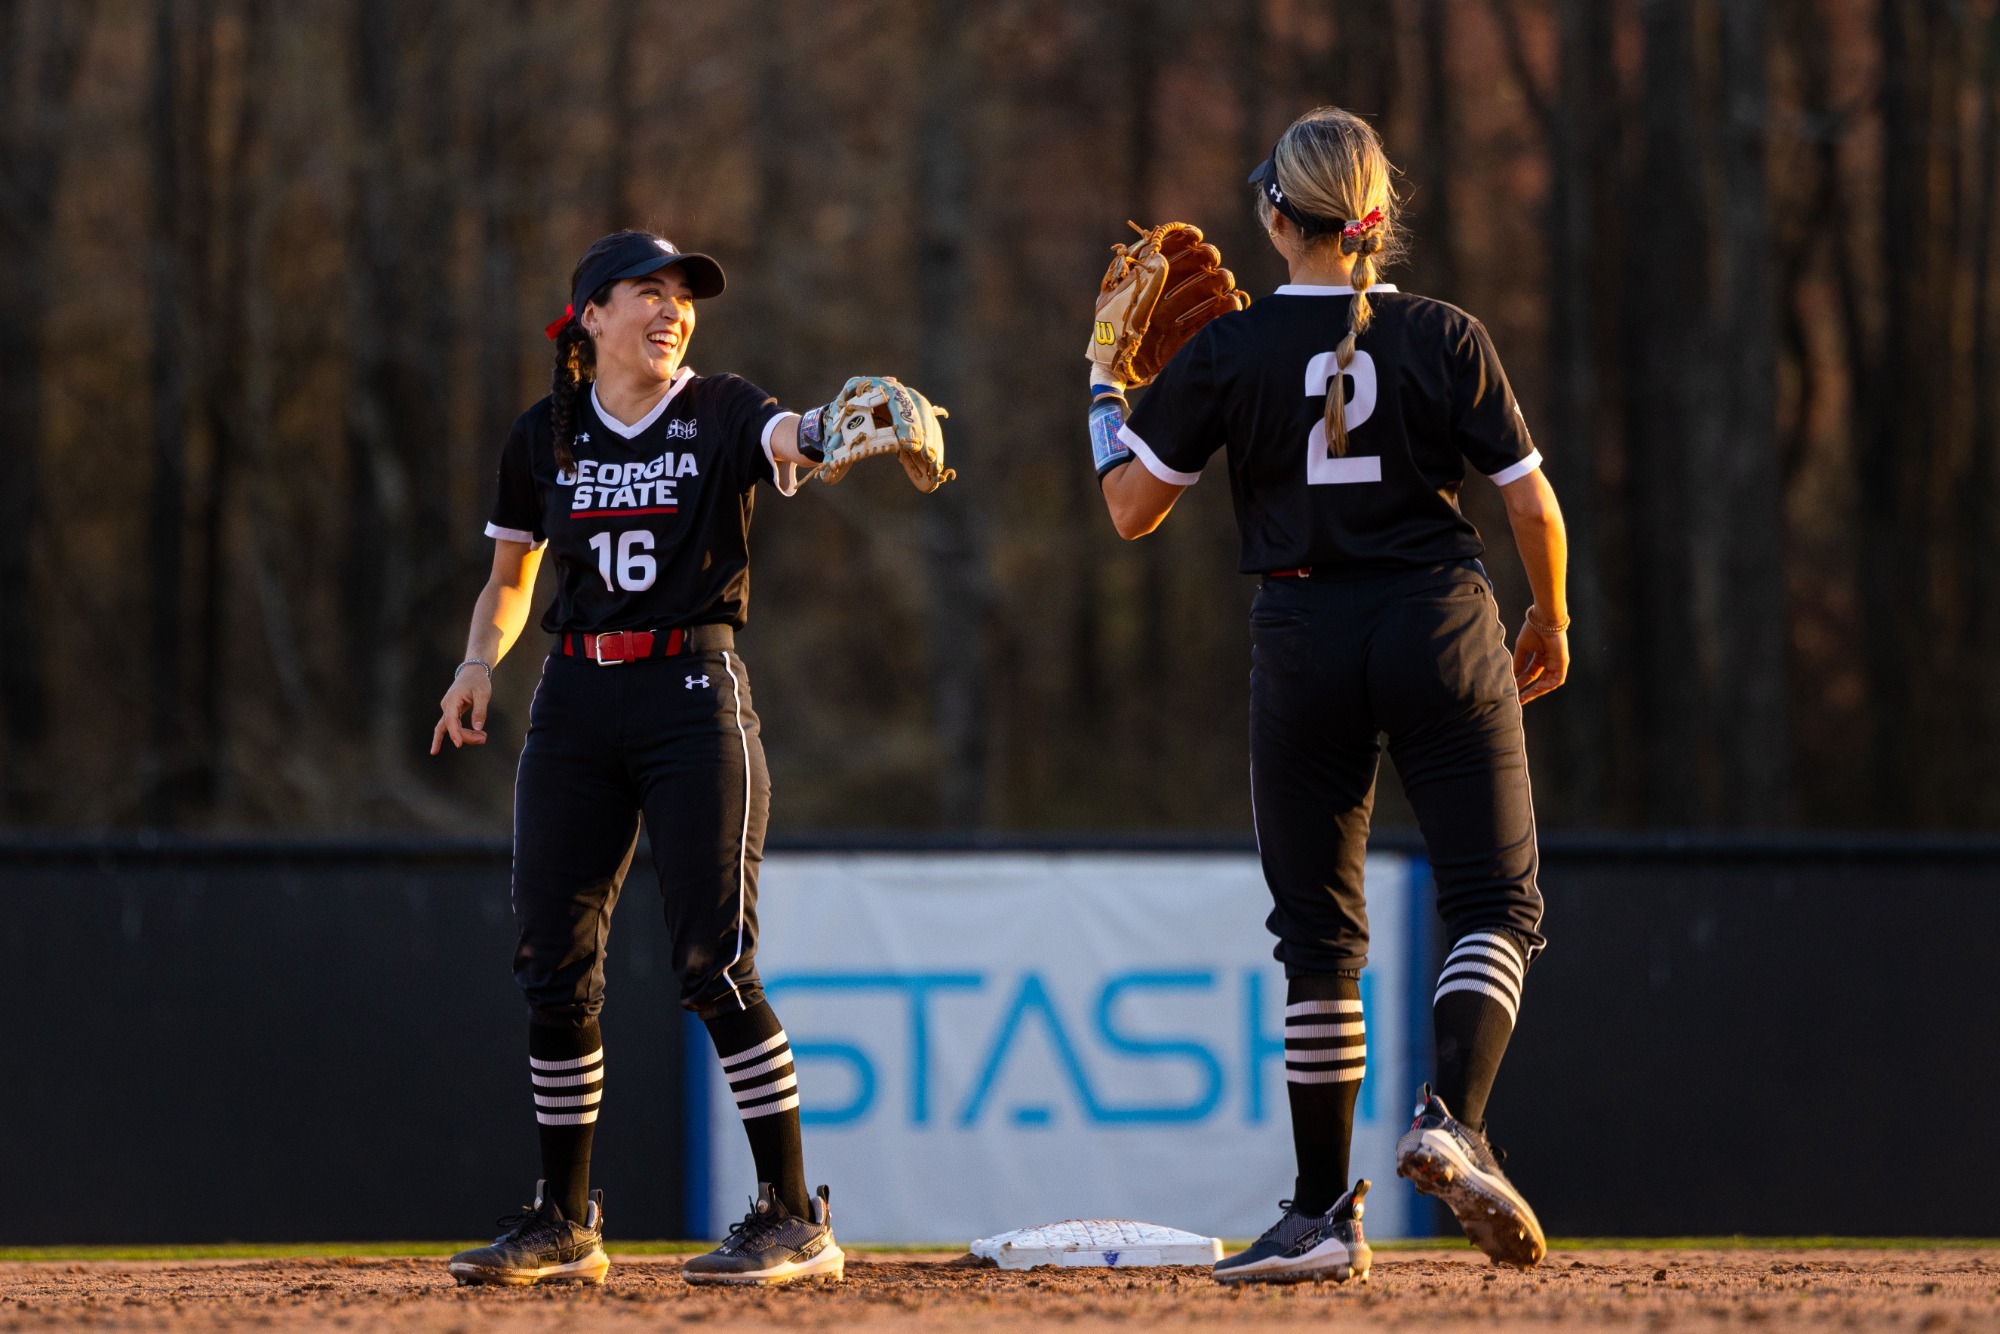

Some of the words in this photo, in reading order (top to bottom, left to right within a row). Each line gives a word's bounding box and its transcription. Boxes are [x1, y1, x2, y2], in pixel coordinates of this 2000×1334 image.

[666, 418, 698, 440] SBC
[1305, 350, 1382, 485] 2
[571, 480, 678, 510] STATE
[588, 529, 657, 592] 16
[762, 972, 1378, 1126] STASH
